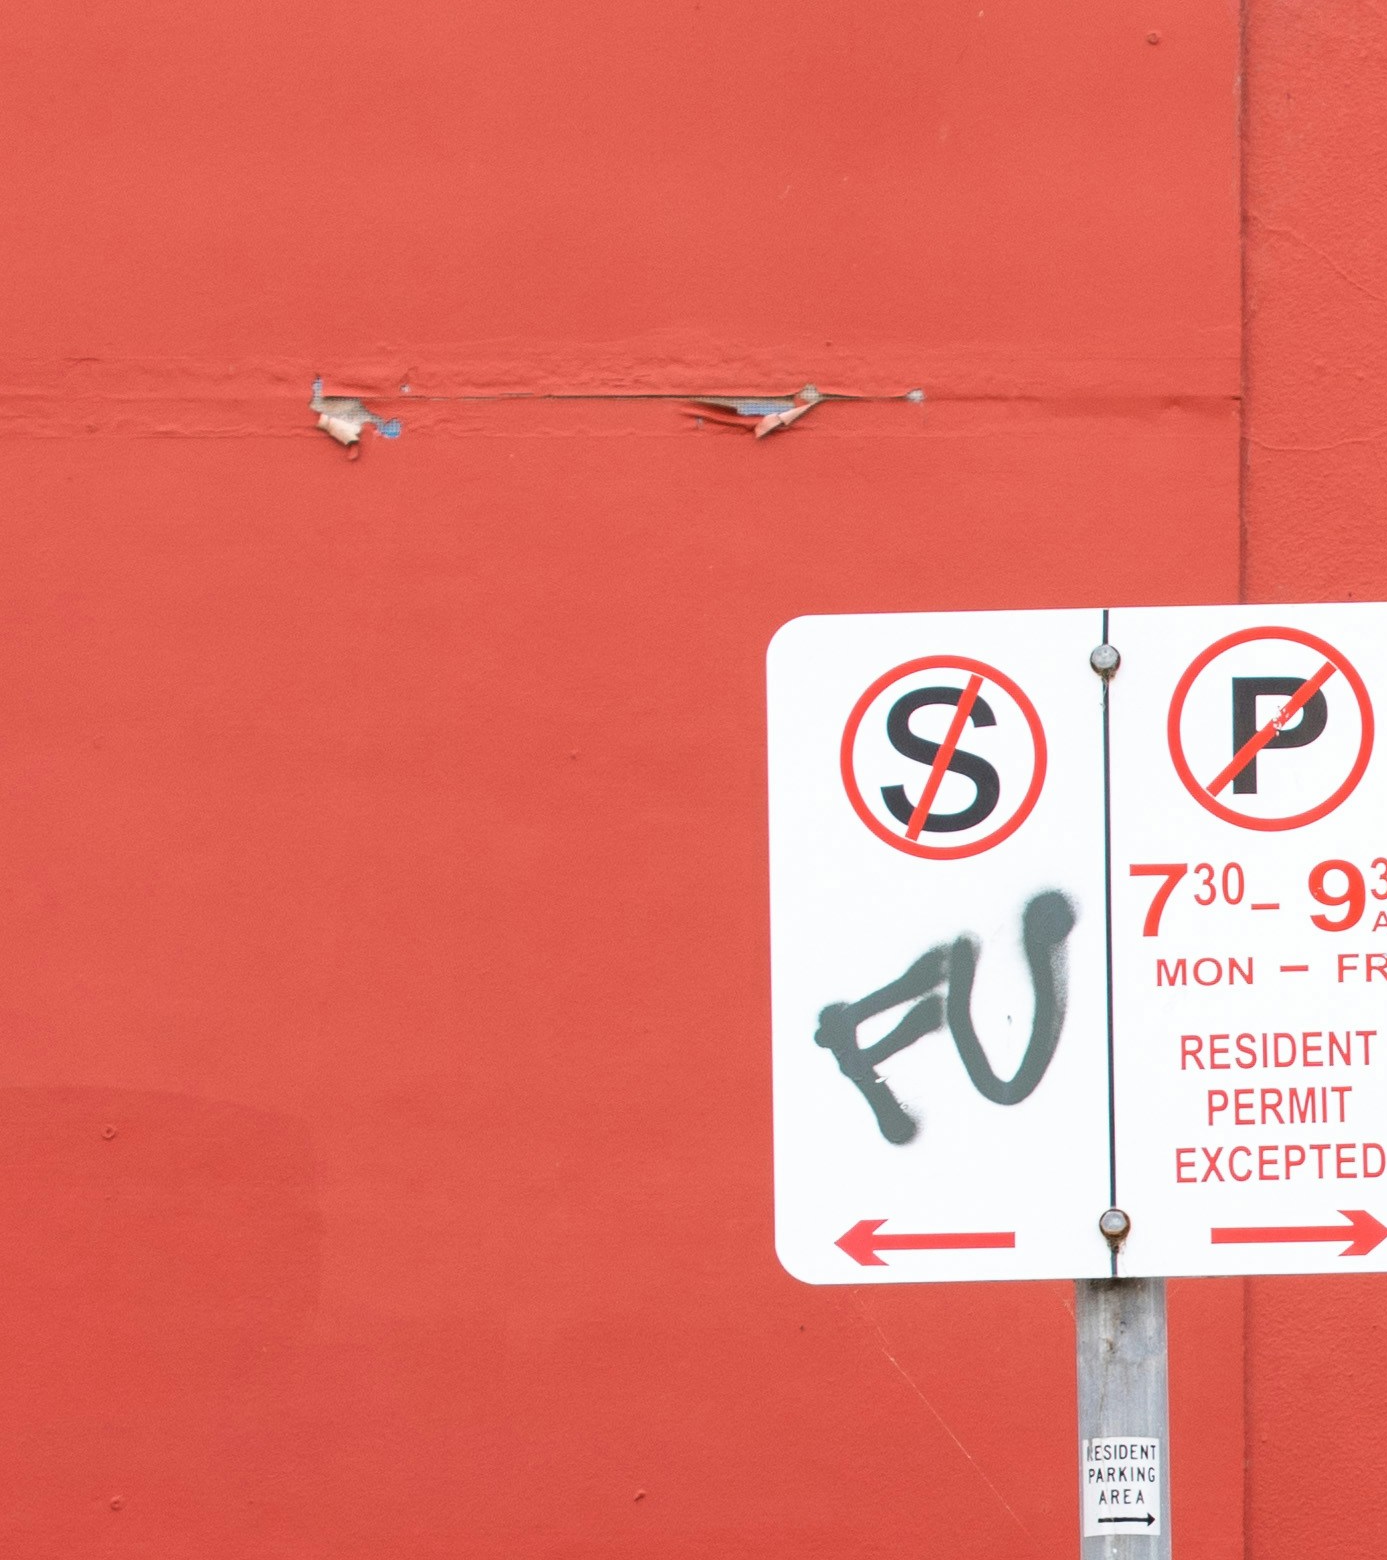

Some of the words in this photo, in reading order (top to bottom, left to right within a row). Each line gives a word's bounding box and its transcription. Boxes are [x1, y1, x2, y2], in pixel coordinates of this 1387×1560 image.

[1231, 676, 1328, 795] P
[879, 686, 1000, 833] S
[1156, 957, 1254, 987] MON
[1180, 1030, 1377, 1070] RESIDENT
[1207, 1085, 1352, 1126] PERMIT
[1175, 1142, 1387, 1184] EXCEPTED
[1088, 1466, 1156, 1484] PARKING
[1098, 1488, 1145, 1505] AREA
